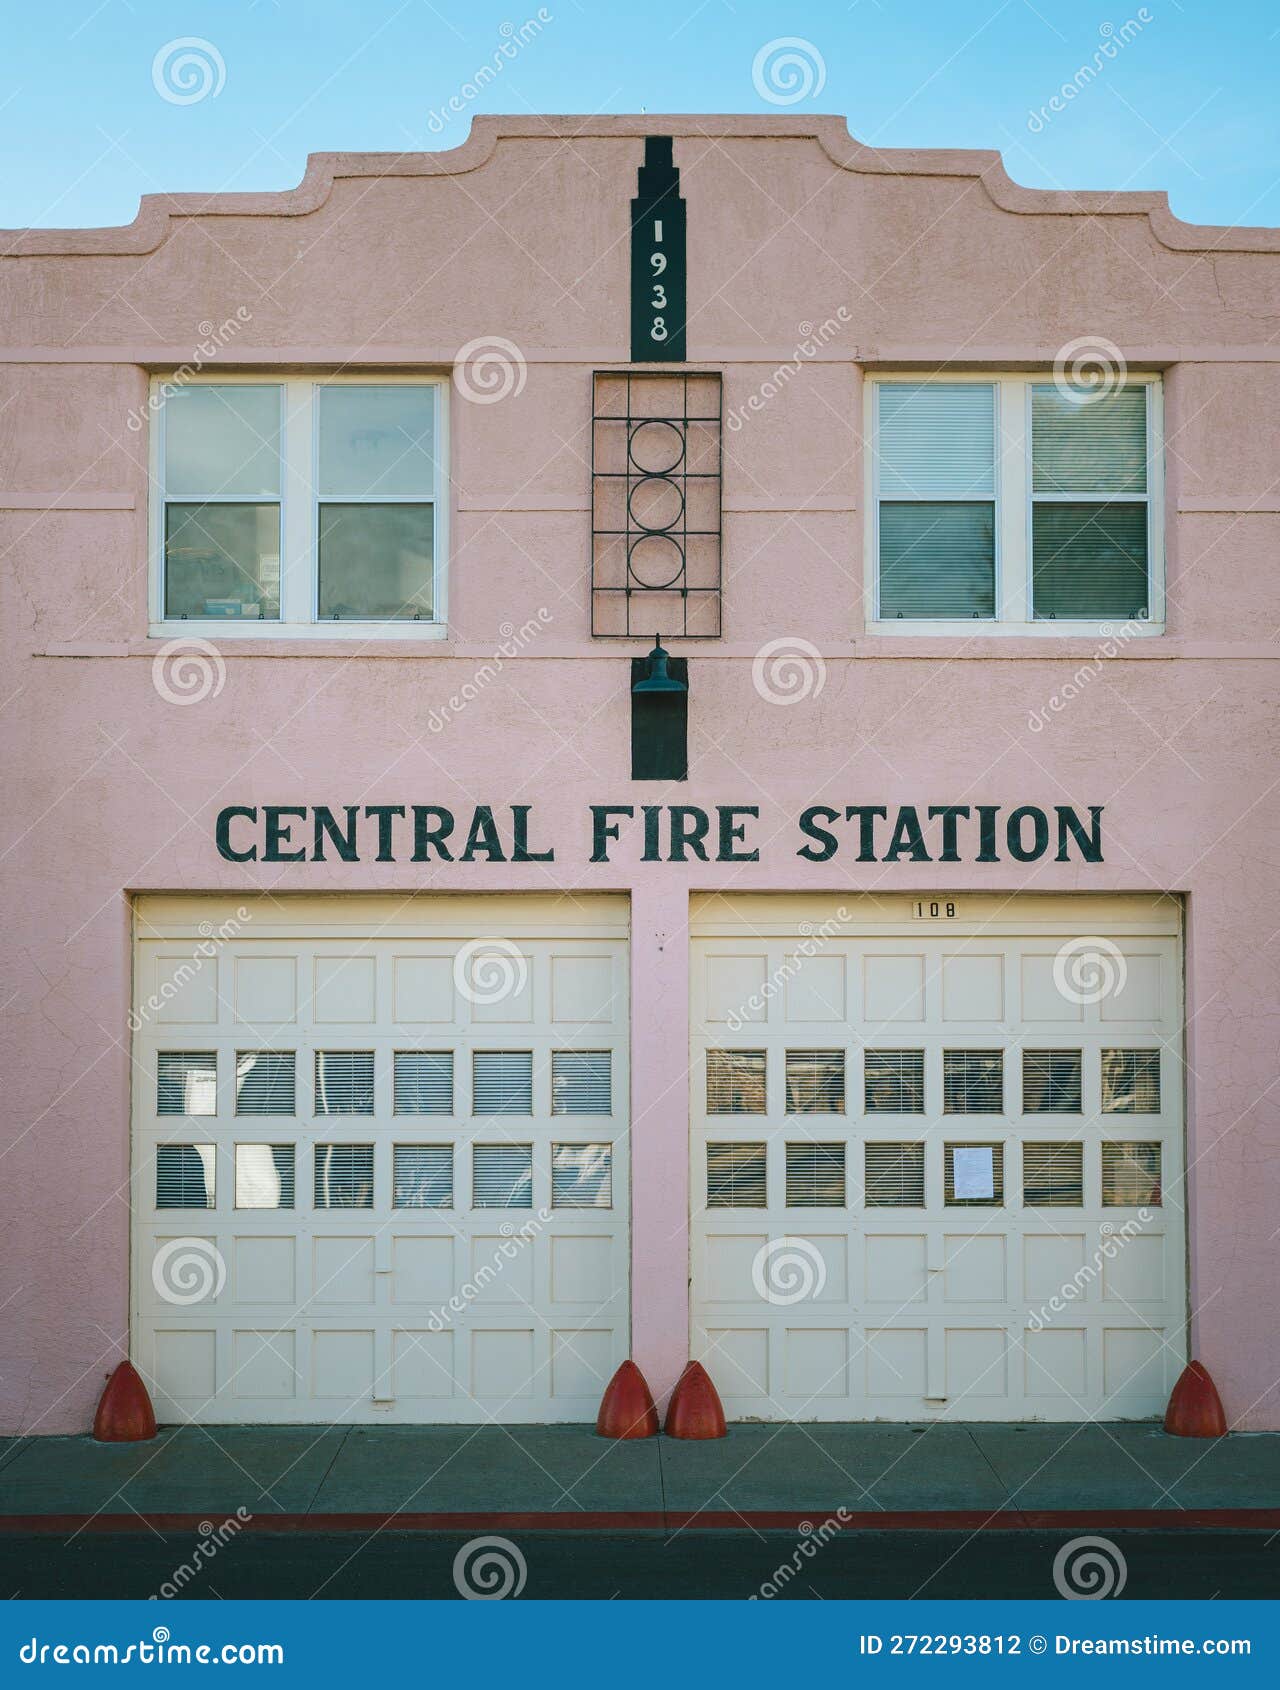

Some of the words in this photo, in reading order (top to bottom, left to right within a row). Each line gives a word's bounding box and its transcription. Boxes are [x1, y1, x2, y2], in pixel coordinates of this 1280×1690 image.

[650, 220, 668, 341] 1938
[215, 805, 555, 863] CENTRAL
[588, 805, 760, 863] FIRE
[796, 805, 1105, 863] STATION
[917, 901, 956, 918] 108
